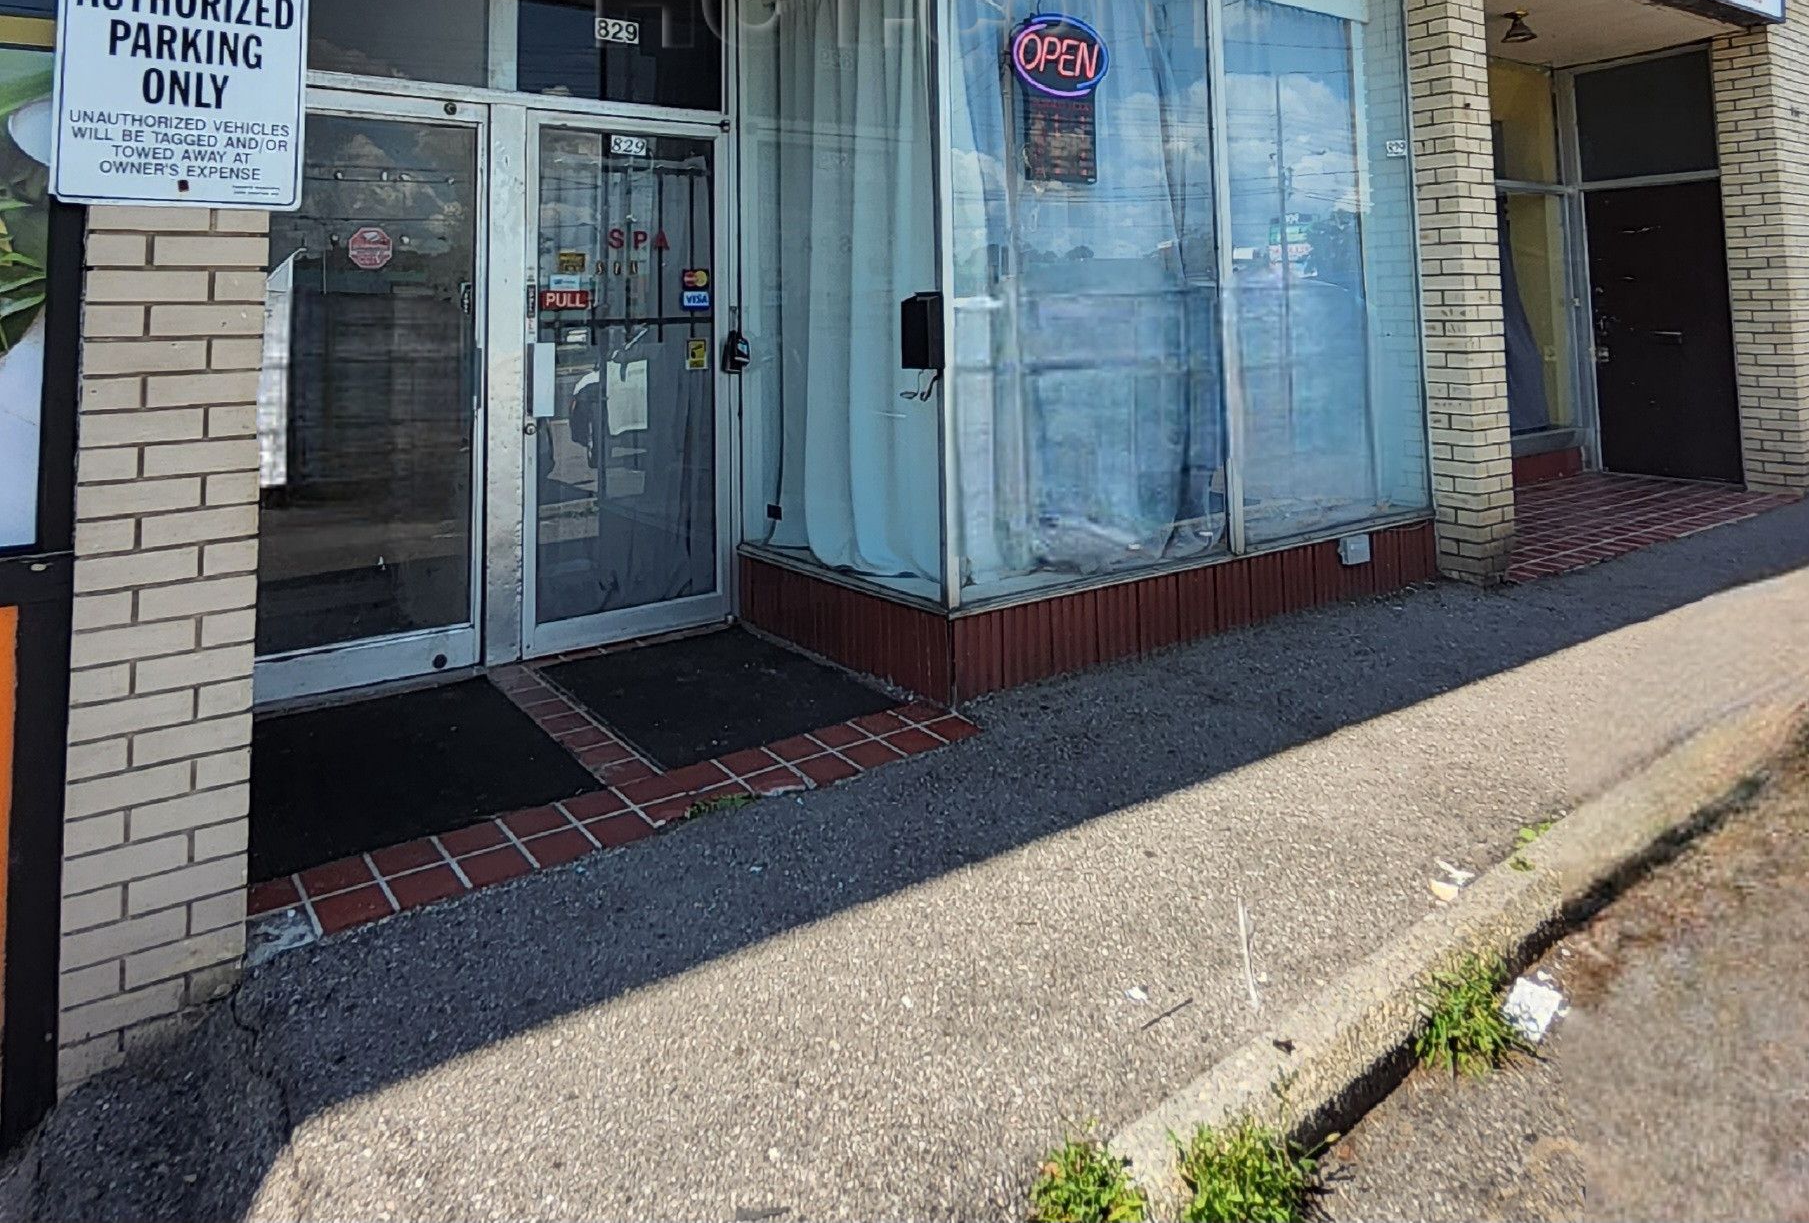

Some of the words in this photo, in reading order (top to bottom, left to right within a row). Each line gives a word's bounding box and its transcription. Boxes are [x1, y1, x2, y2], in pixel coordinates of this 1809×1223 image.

[596, 19, 639, 43] 829
[108, 19, 263, 70] PARKING
[1018, 32, 1100, 79] OPEN
[142, 67, 229, 109] ONLY
[69, 109, 207, 132] UNAUTHORIZED
[212, 120, 290, 138] VEHICLES
[71, 126, 113, 142] WILL
[121, 130, 144, 143] BE
[151, 130, 218, 149] TAGGED
[223, 135, 288, 154] AND/OR
[610, 136, 647, 156] 829
[112, 144, 174, 161] TOWED
[181, 148, 227, 164] AWAY
[233, 151, 253, 165] AT
[99, 159, 180, 177] OWNER'S
[186, 164, 261, 181] EXPENSE
[608, 228, 670, 252] SPA
[545, 292, 586, 309] PULL
[686, 294, 709, 304] VISA
